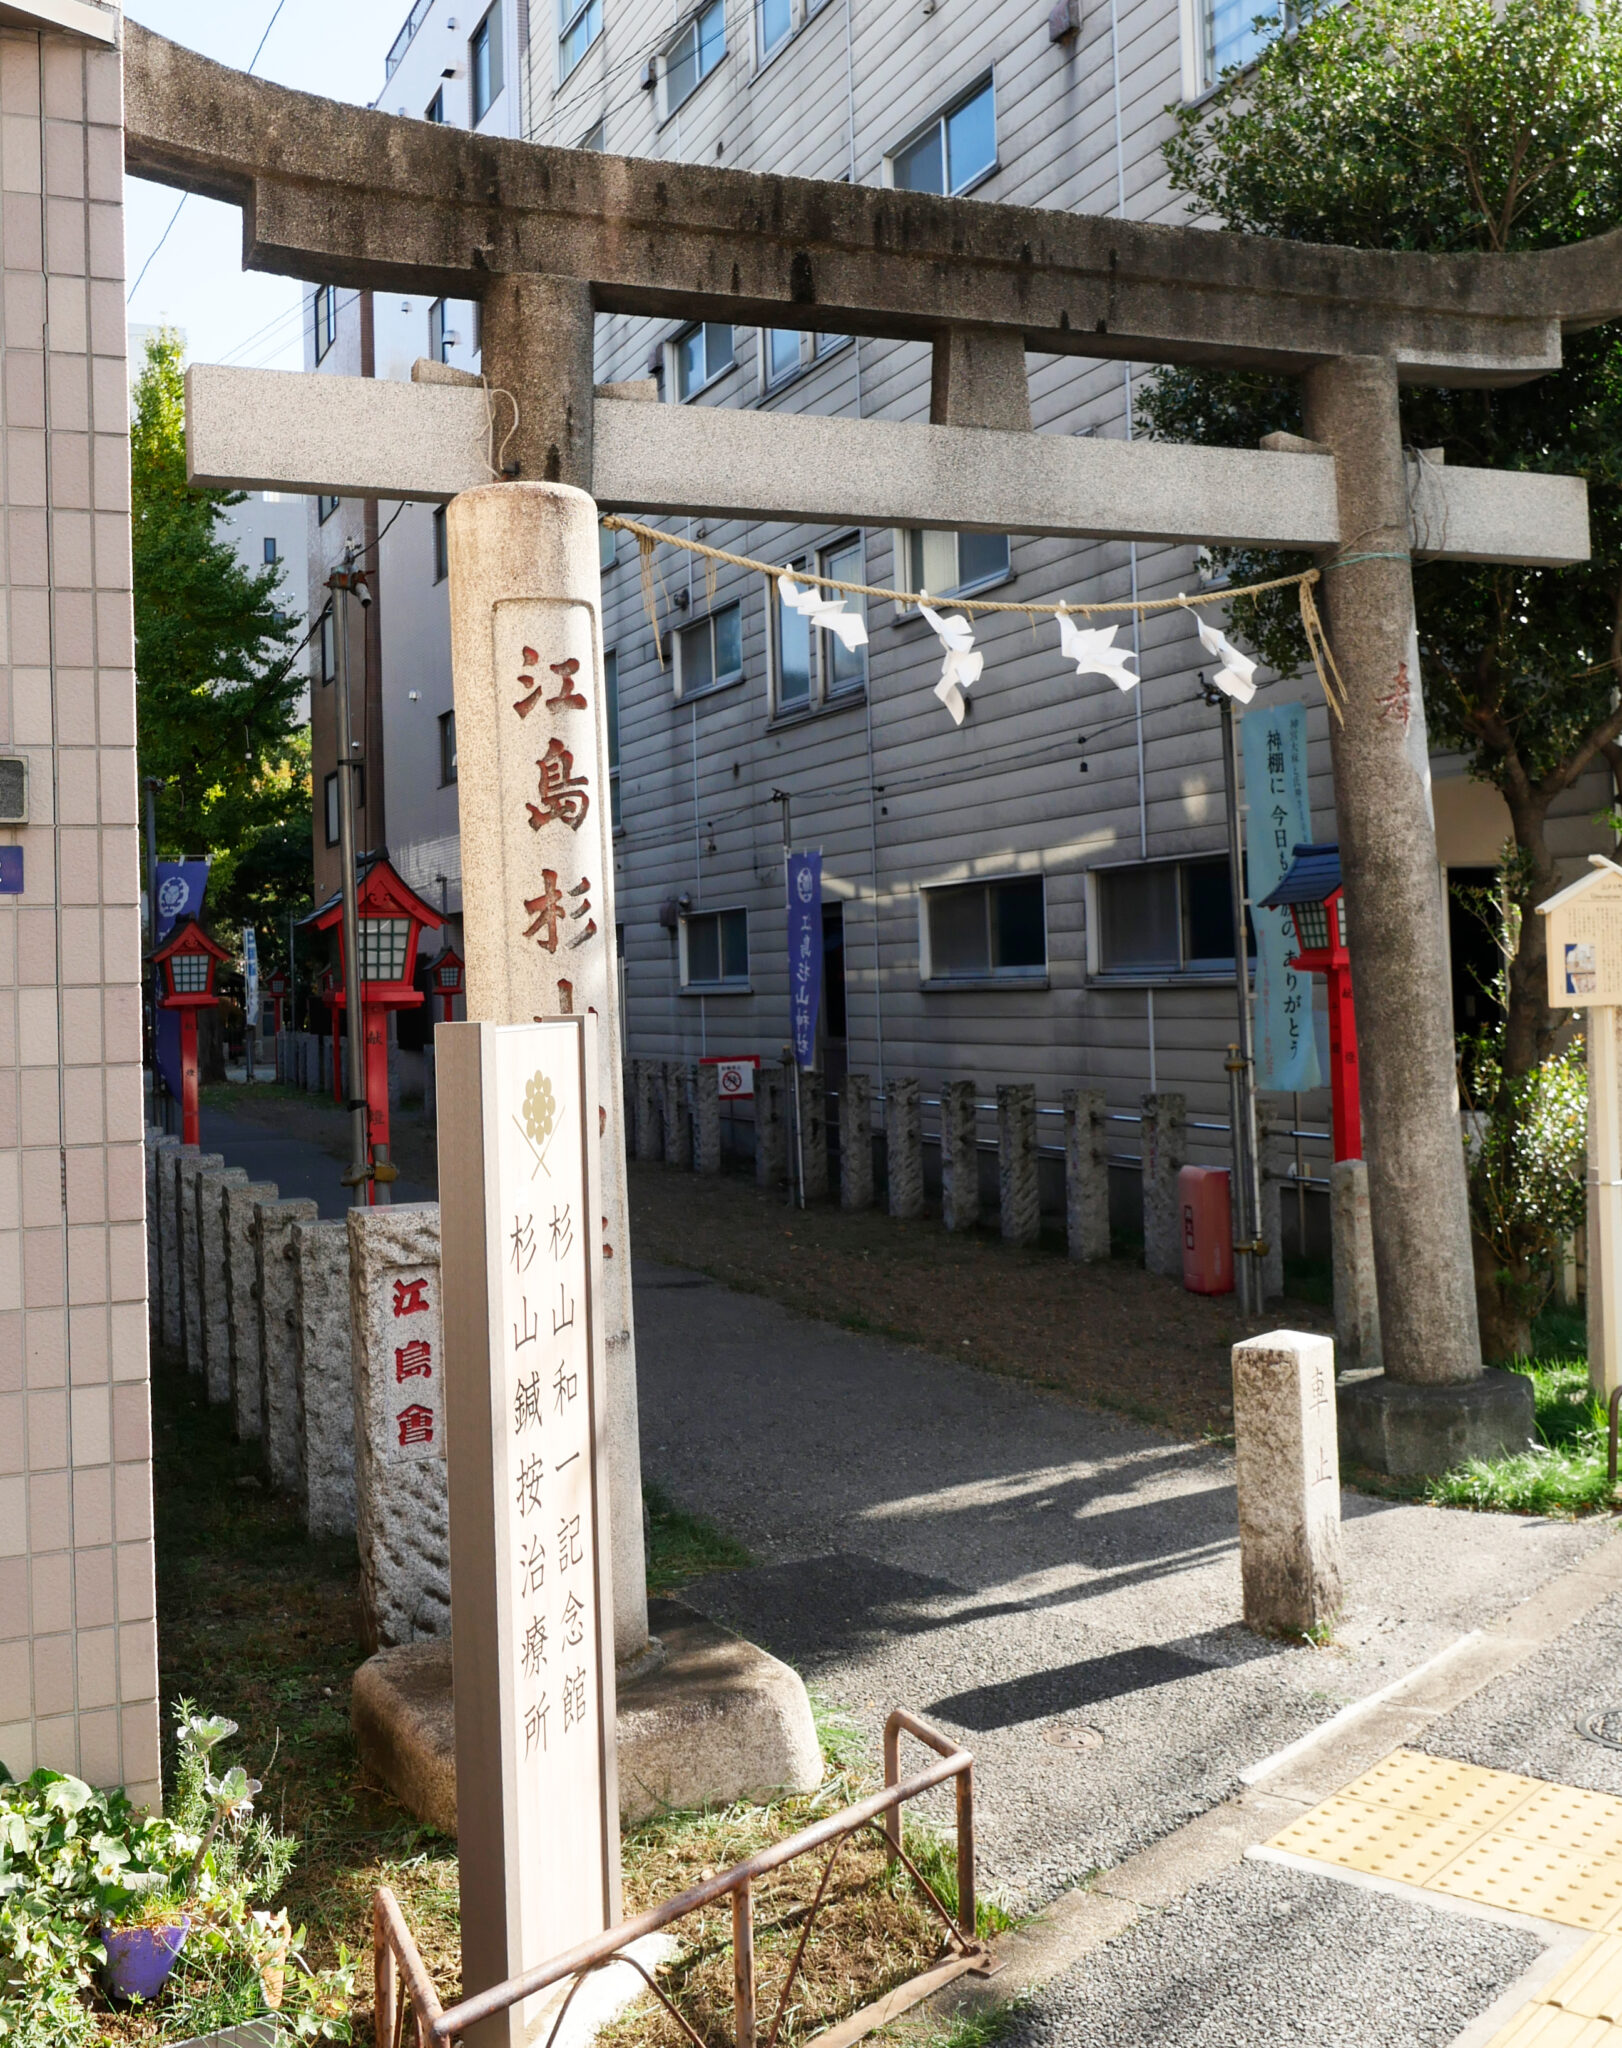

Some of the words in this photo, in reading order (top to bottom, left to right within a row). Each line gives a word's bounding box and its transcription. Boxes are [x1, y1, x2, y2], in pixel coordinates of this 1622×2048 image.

[513, 645, 599, 1016] 江島杉
[1266, 729, 1285, 794] 神棚に
[510, 1213, 551, 1762] 杉山鍼按治療所
[548, 1203, 587, 1735] 杉山和一記念館
[1308, 1366, 1332, 1486] 車止
